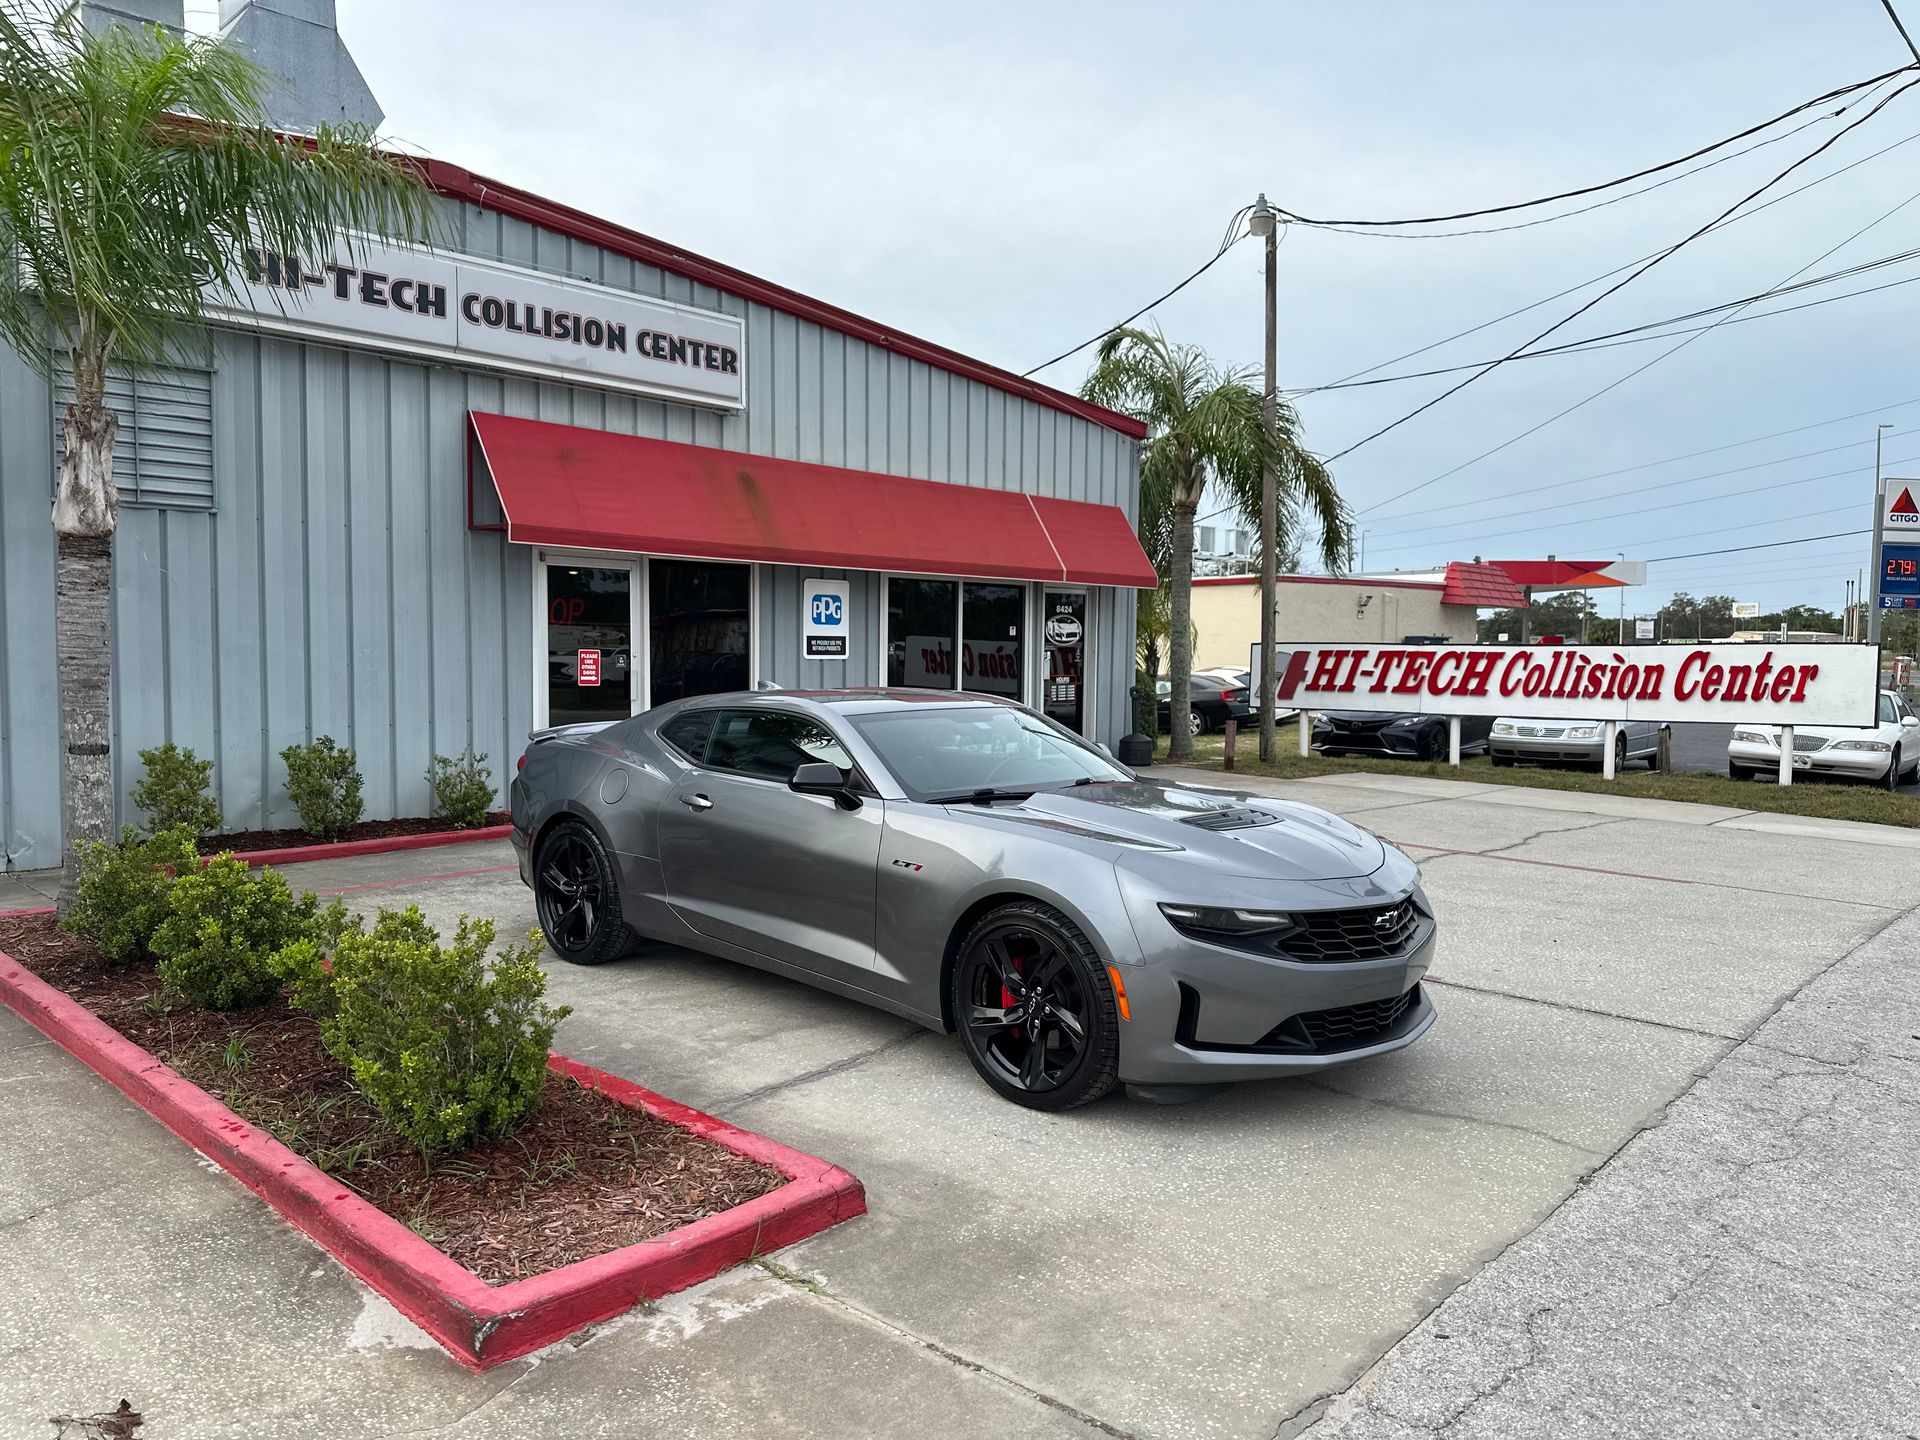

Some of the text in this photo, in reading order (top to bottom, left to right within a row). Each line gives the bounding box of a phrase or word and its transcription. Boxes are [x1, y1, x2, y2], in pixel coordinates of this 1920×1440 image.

[246, 249, 738, 376] HI-TECH COLLISION CENTER
[1890, 514, 1919, 523] CITGO
[813, 597, 841, 623] PPG
[1056, 605, 1073, 614] 8424
[1304, 650, 1819, 702] HI-TECH Collision Center
[892, 859, 923, 872] LT1
